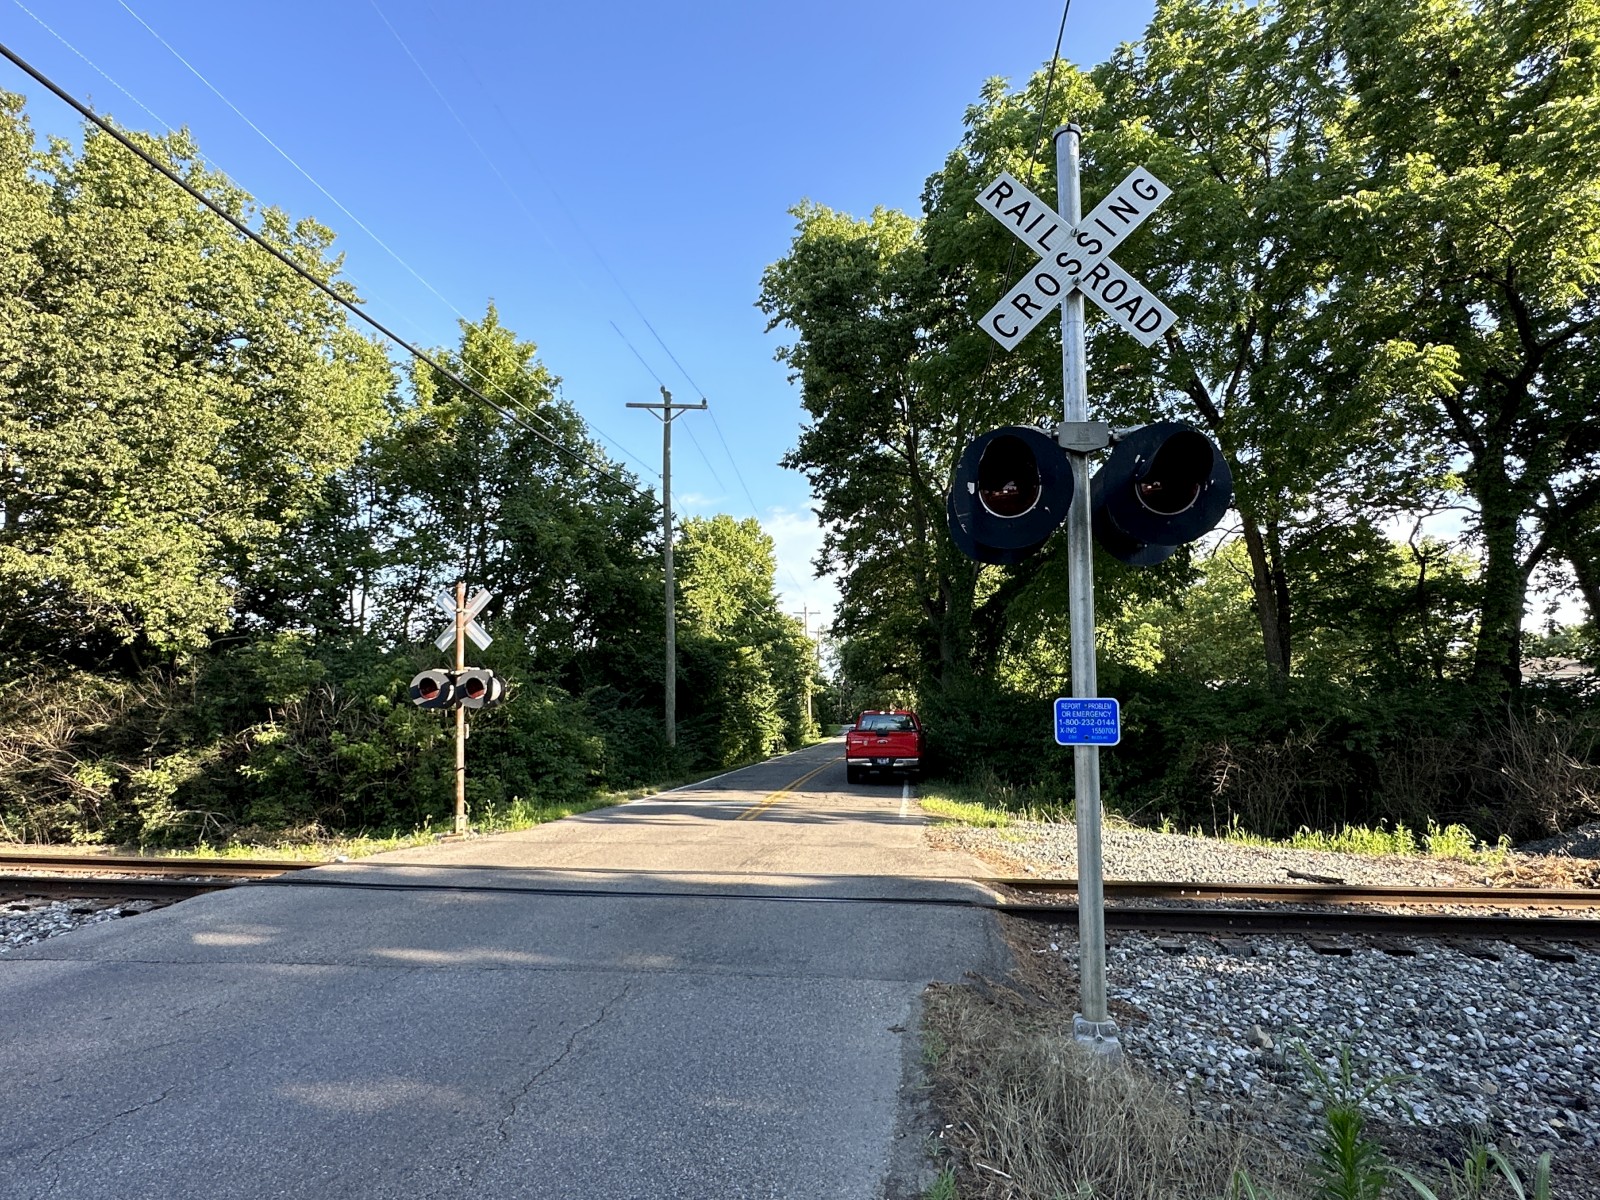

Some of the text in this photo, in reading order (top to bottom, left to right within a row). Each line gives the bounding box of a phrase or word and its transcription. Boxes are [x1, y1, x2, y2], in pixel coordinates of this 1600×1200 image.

[986, 180, 1162, 333] RAIL ROAD
[993, 178, 1158, 338] CROSSING
